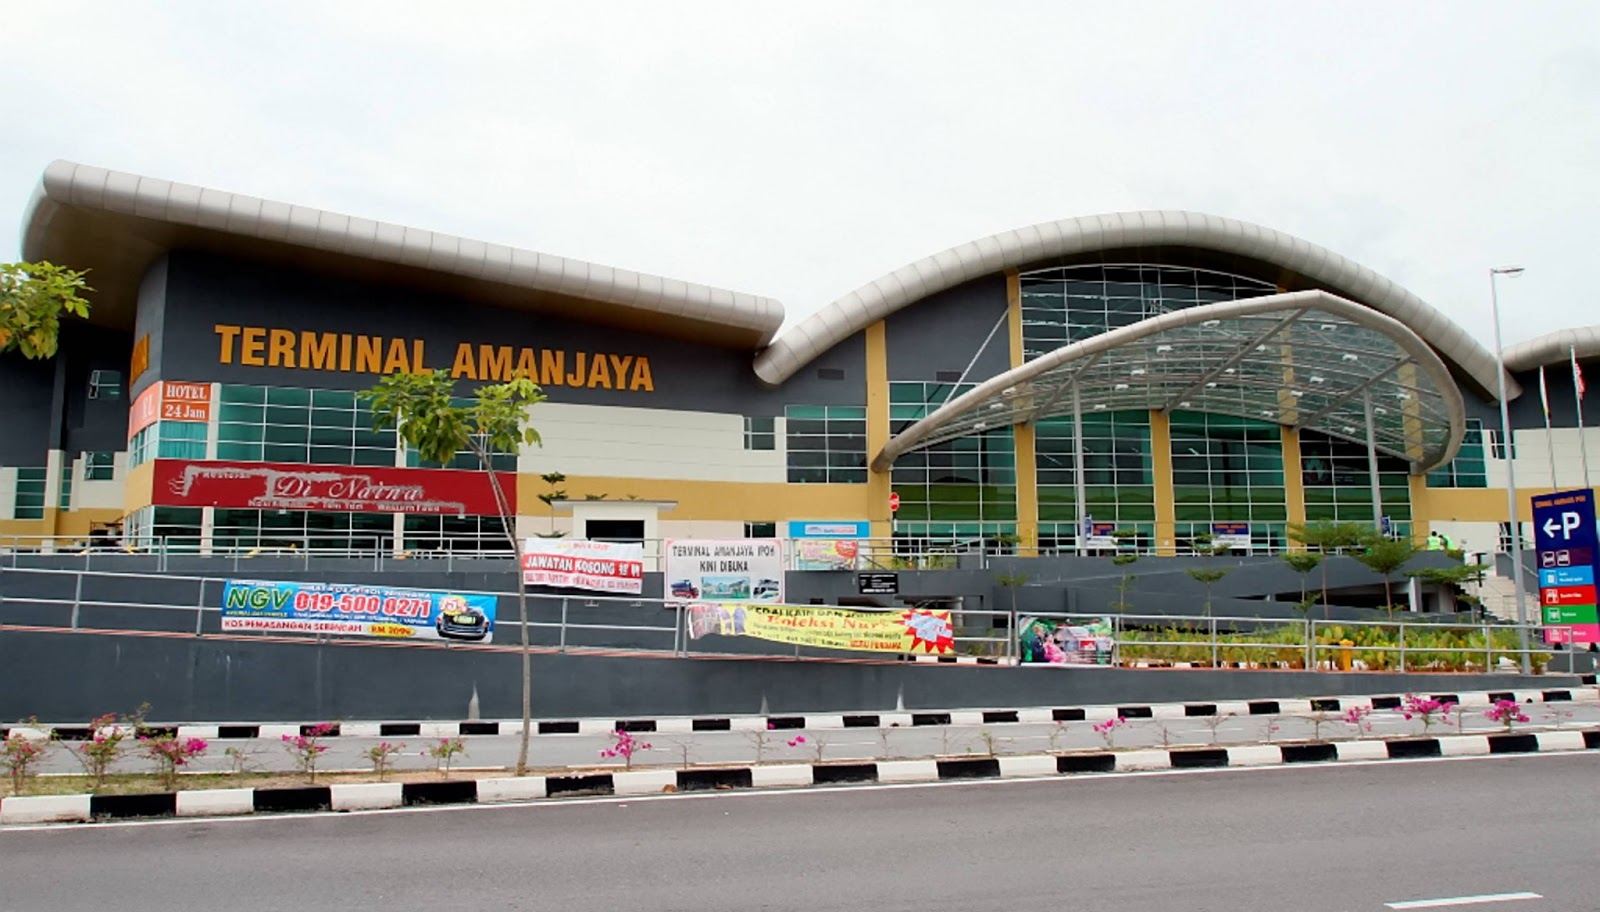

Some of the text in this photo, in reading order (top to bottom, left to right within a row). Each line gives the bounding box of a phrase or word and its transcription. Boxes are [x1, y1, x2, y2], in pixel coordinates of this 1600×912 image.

[214, 324, 654, 392] TERMINAL AMANJAYA
[166, 385, 207, 400] HOTEL
[165, 404, 183, 418] 24
[184, 404, 206, 419] Jam
[1562, 511, 1581, 540] P
[672, 545, 776, 557] TERMINAL AMANJAYA IPOH
[526, 555, 615, 575] JAWATAN KOSONG
[699, 560, 749, 573] KINI DIBUKA
[226, 586, 293, 609] NGV
[294, 591, 380, 614] 019-500
[382, 597, 431, 618] 0271
[224, 619, 243, 628] KOS
[245, 620, 312, 631] PEMASANGAN
